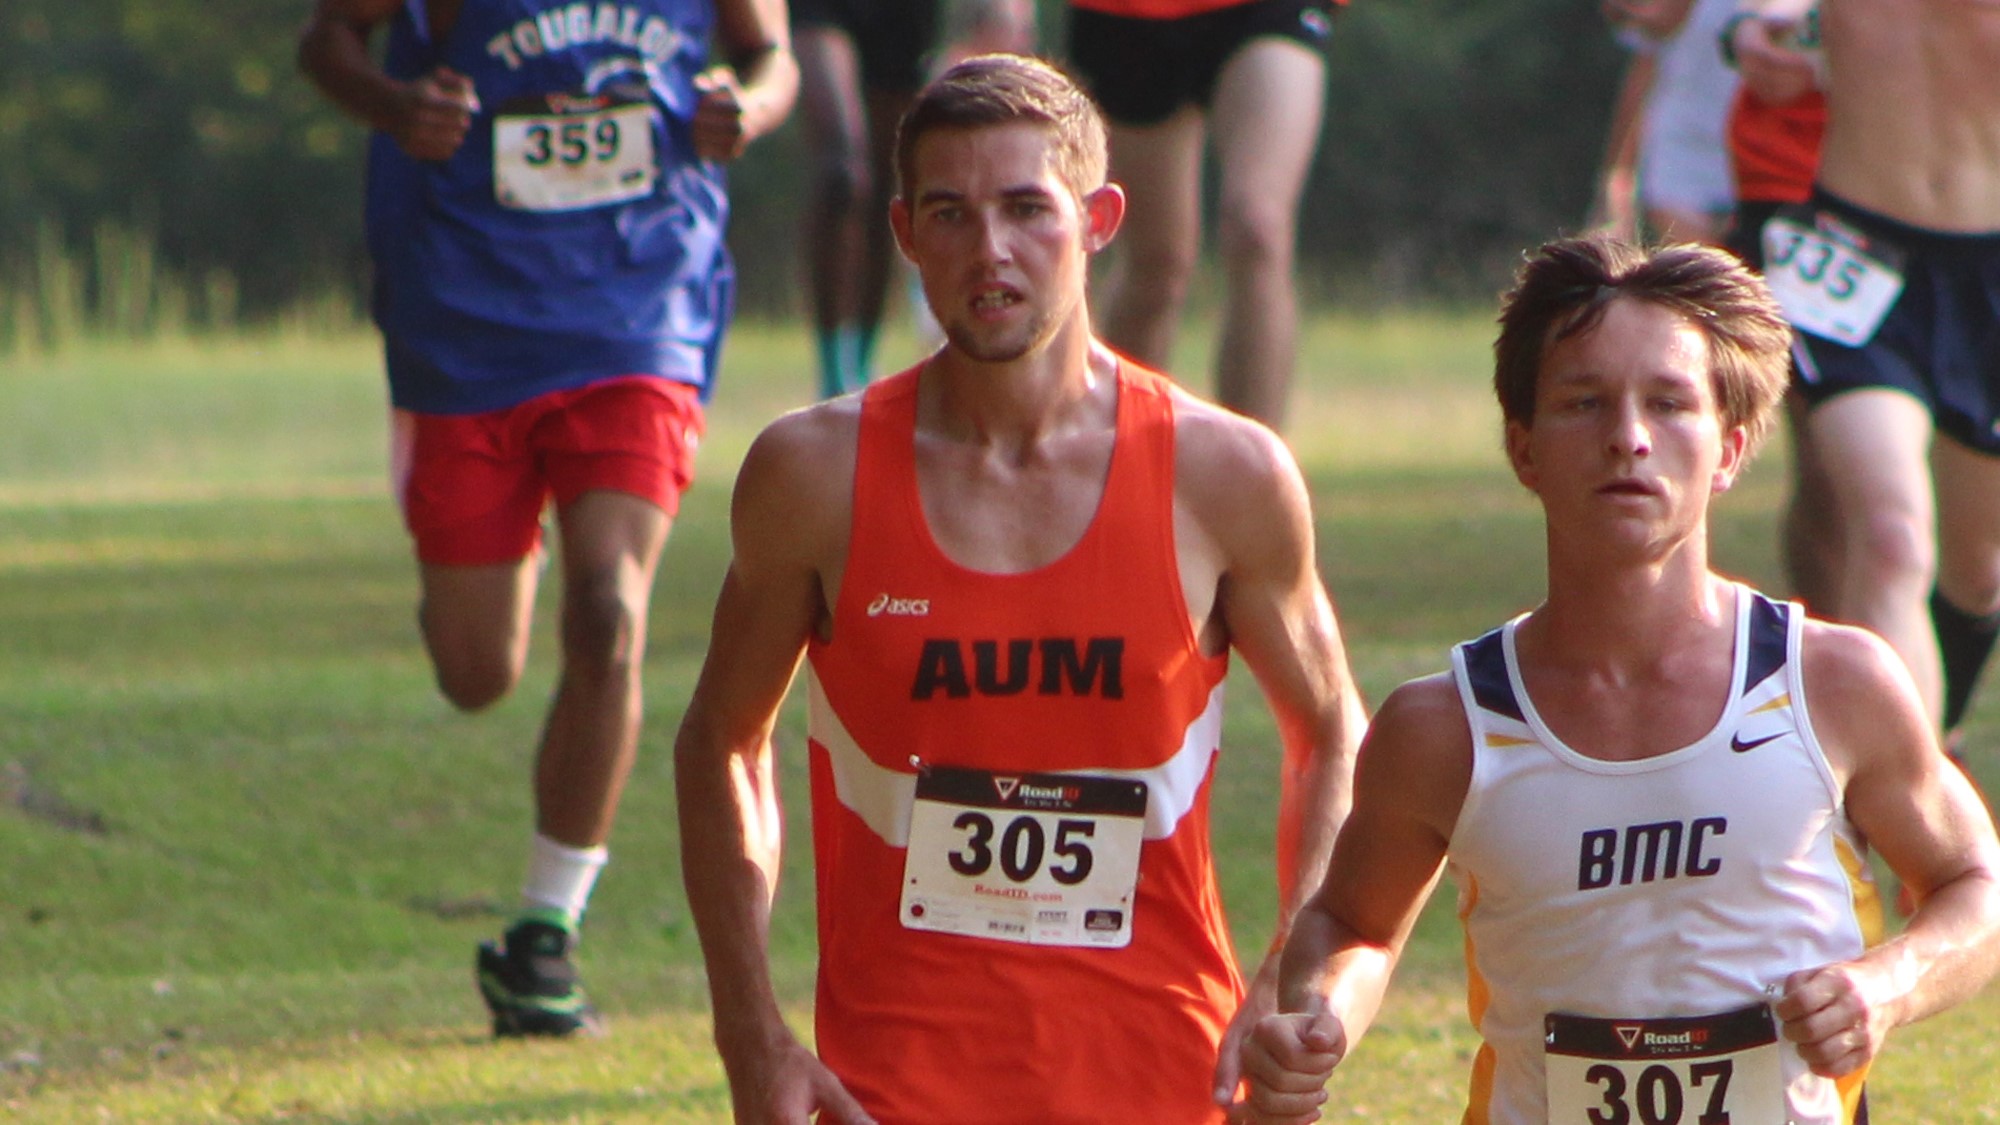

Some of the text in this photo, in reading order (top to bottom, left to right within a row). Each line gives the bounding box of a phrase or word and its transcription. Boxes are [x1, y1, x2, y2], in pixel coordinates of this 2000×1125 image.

[524, 120, 622, 167] 359
[887, 598, 930, 616] asics
[910, 636, 1124, 701] AUM
[948, 812, 1095, 886] 305
[1578, 817, 1728, 891] BMC
[974, 884, 1063, 902] RoadID.com
[1584, 1059, 1734, 1125] 307
